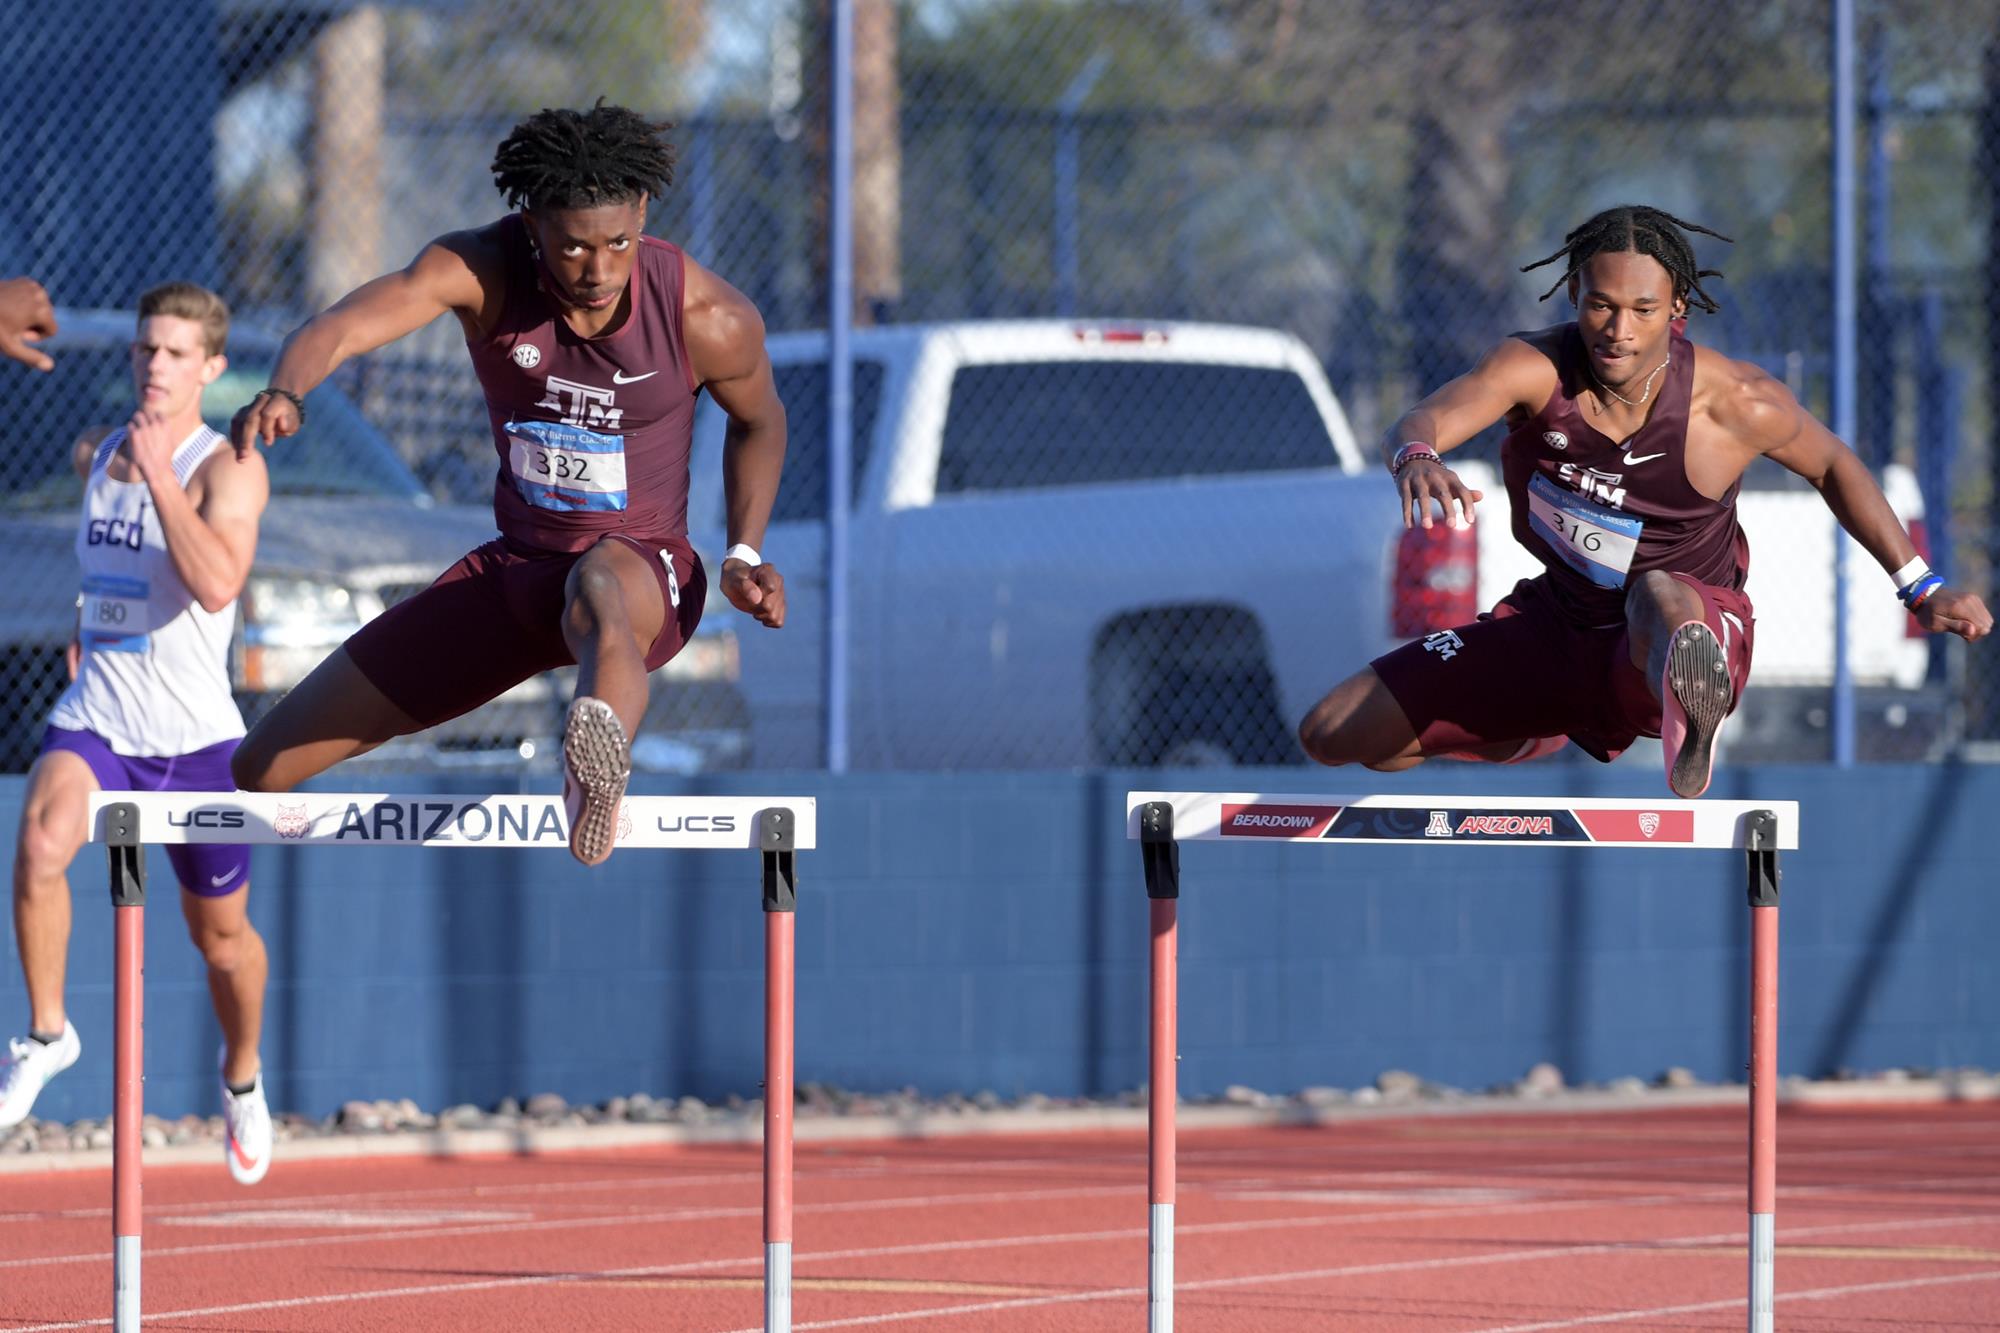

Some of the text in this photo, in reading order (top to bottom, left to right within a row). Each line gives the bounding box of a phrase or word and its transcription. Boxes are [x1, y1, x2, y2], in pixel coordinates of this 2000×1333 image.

[514, 345, 539, 366] SEC
[536, 451, 592, 482] 332
[1552, 512, 1603, 552] 316
[167, 802, 736, 842] UCS ARIZONA UCS
[1231, 813, 1315, 829] BEARDOWN
[1456, 815, 1554, 836] ARIZONA
